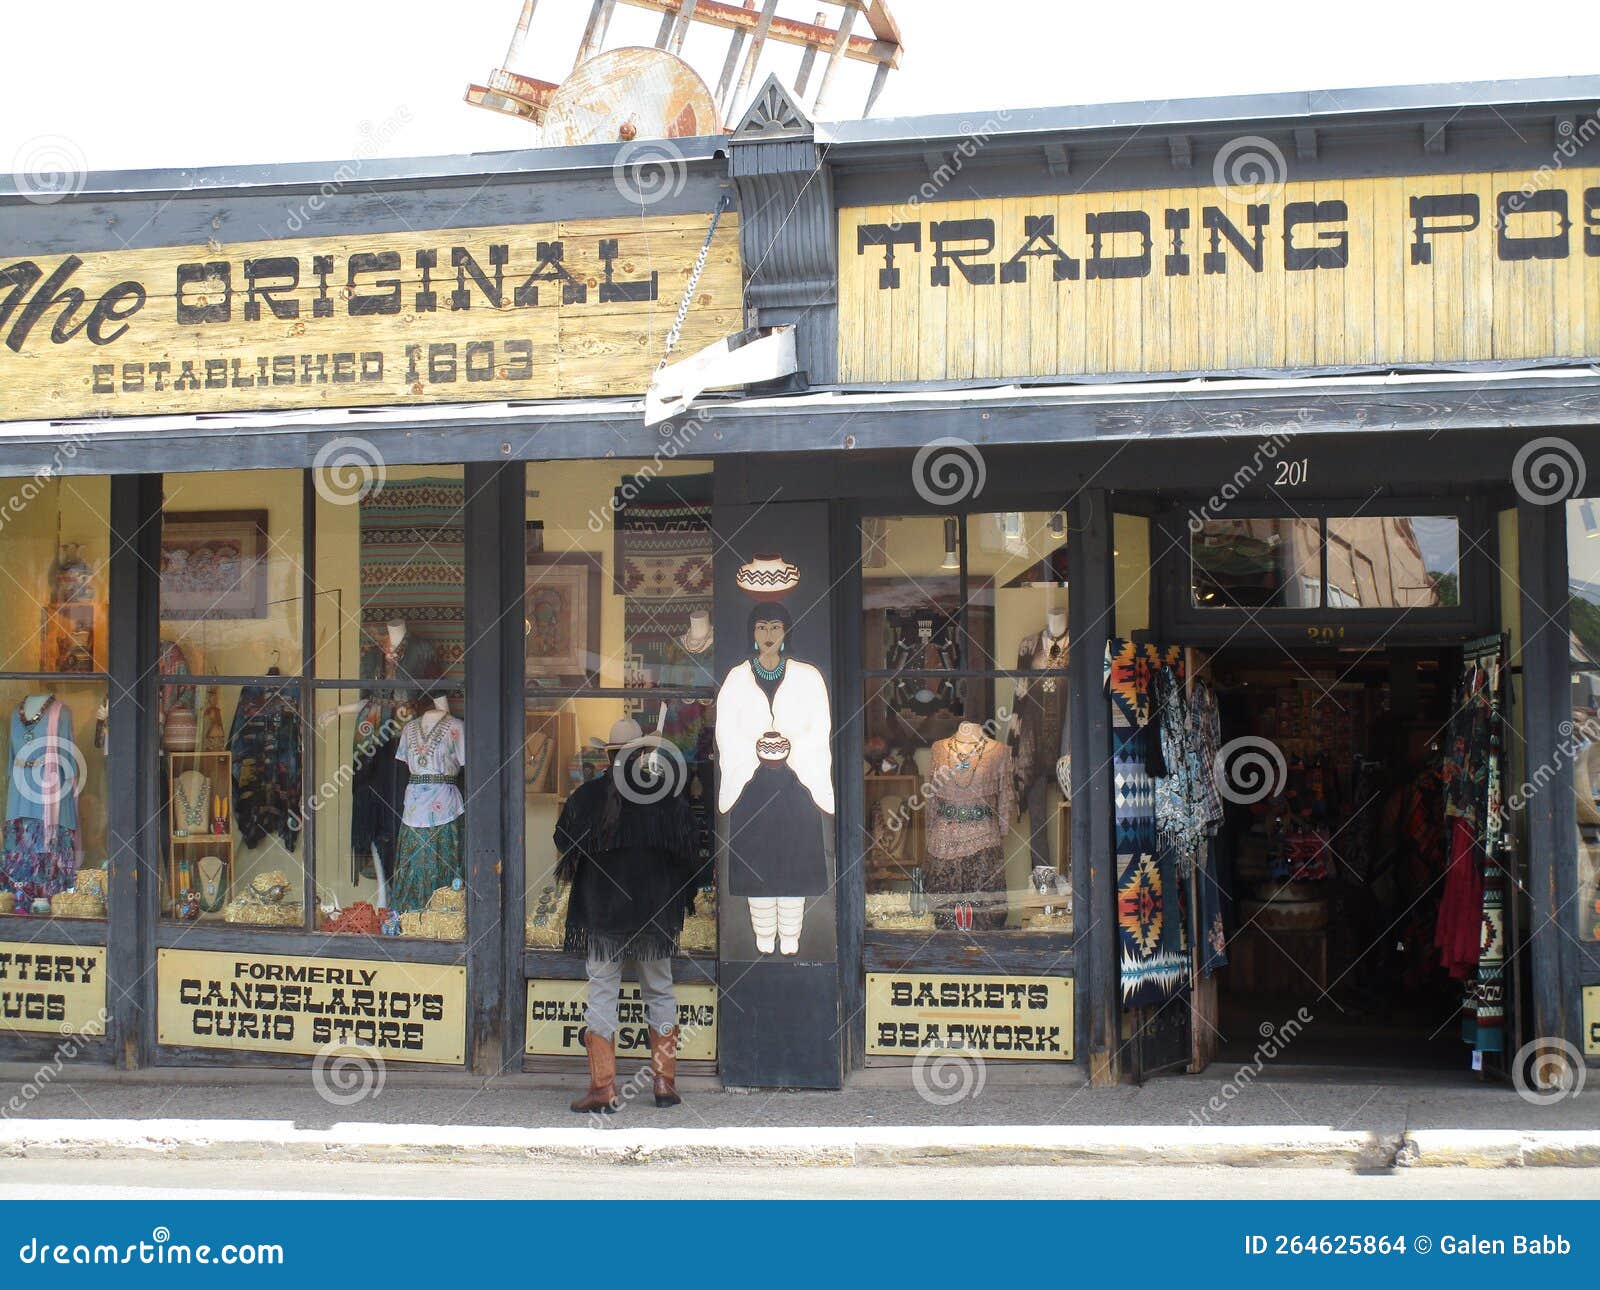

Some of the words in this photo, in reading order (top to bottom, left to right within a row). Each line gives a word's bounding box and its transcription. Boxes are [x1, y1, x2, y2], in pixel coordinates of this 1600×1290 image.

[857, 200, 1349, 290] TRADING
[1410, 187, 1600, 266] PO
[176, 238, 660, 325] ORIGINAL
[92, 351, 384, 394] ESTABLISHED
[405, 339, 533, 385] 1603
[1274, 458, 1311, 485] 201
[235, 963, 377, 986] FORMERLY
[2, 992, 65, 1020] UGS
[180, 979, 443, 1020] CANDELARIO'S
[891, 982, 1049, 1009] BASKETS
[193, 1009, 294, 1040] CURIO
[312, 1017, 424, 1049] STORE
[878, 1022, 1060, 1051] BEADWORK
